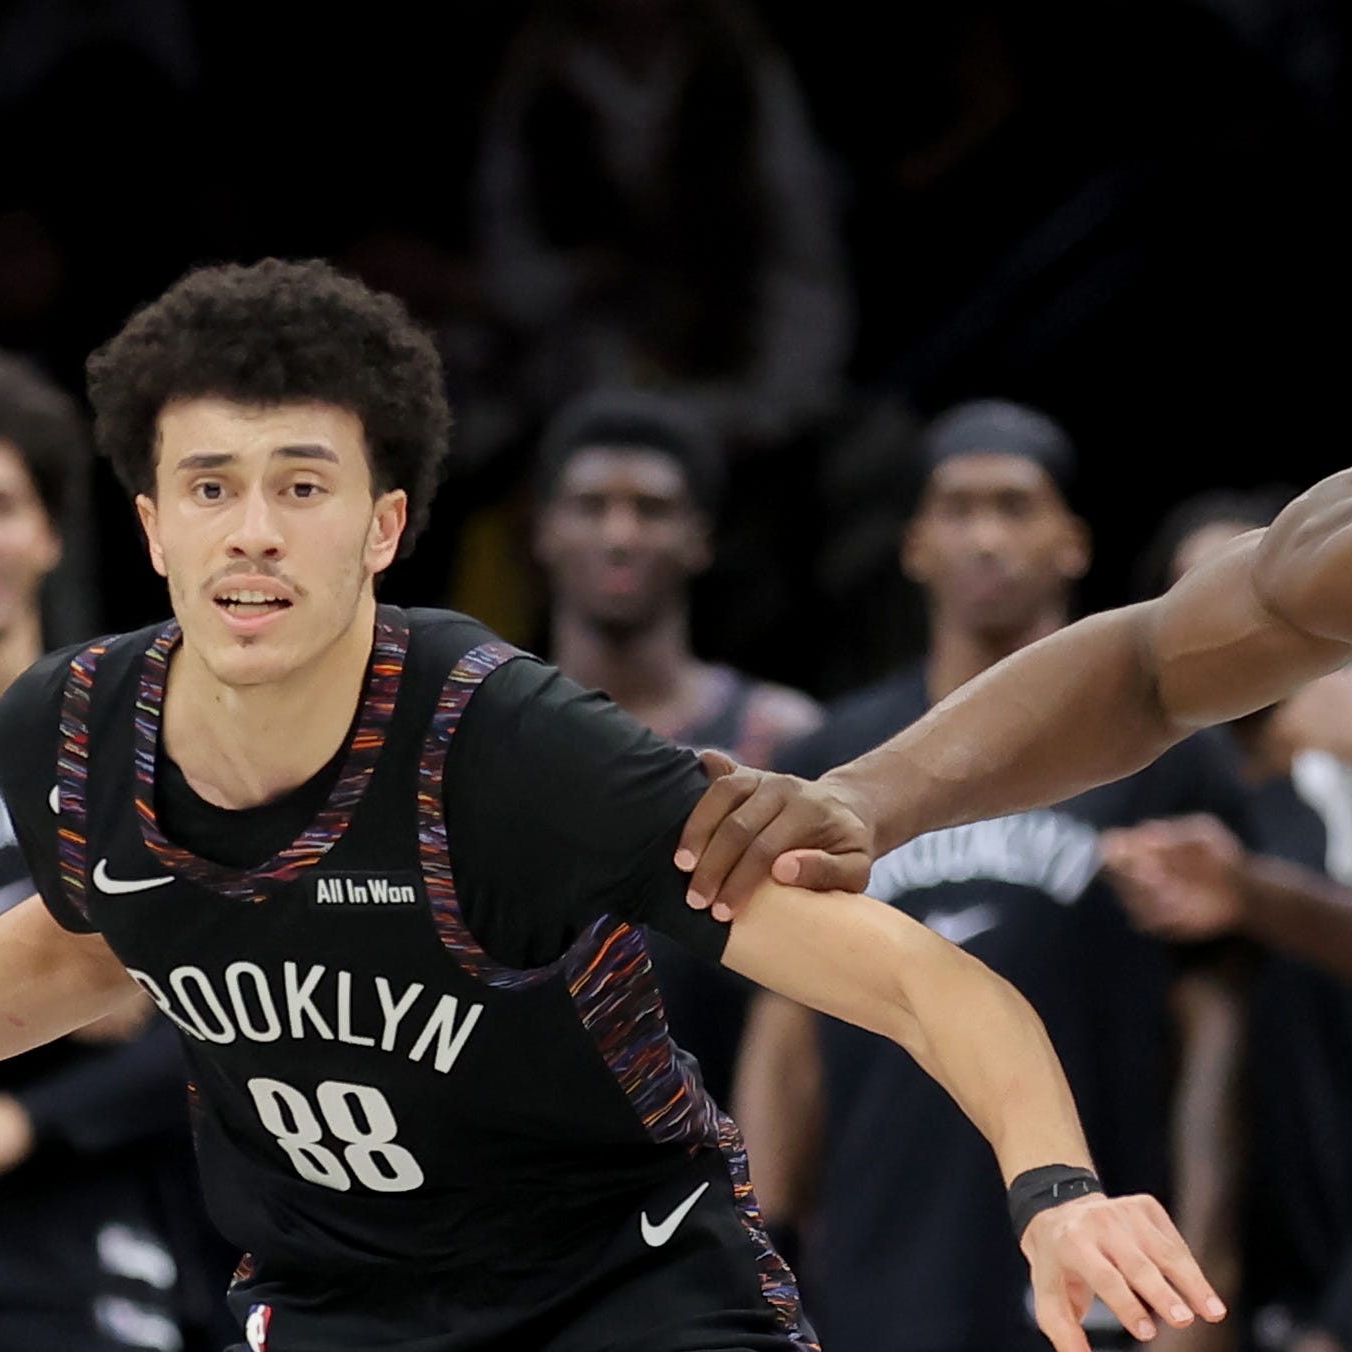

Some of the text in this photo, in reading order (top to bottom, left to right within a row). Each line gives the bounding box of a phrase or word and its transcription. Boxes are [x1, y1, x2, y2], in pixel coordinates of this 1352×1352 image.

[316, 878, 416, 904] All In Won
[125, 960, 485, 1074] ROOKLYN
[247, 1077, 424, 1192] 88
